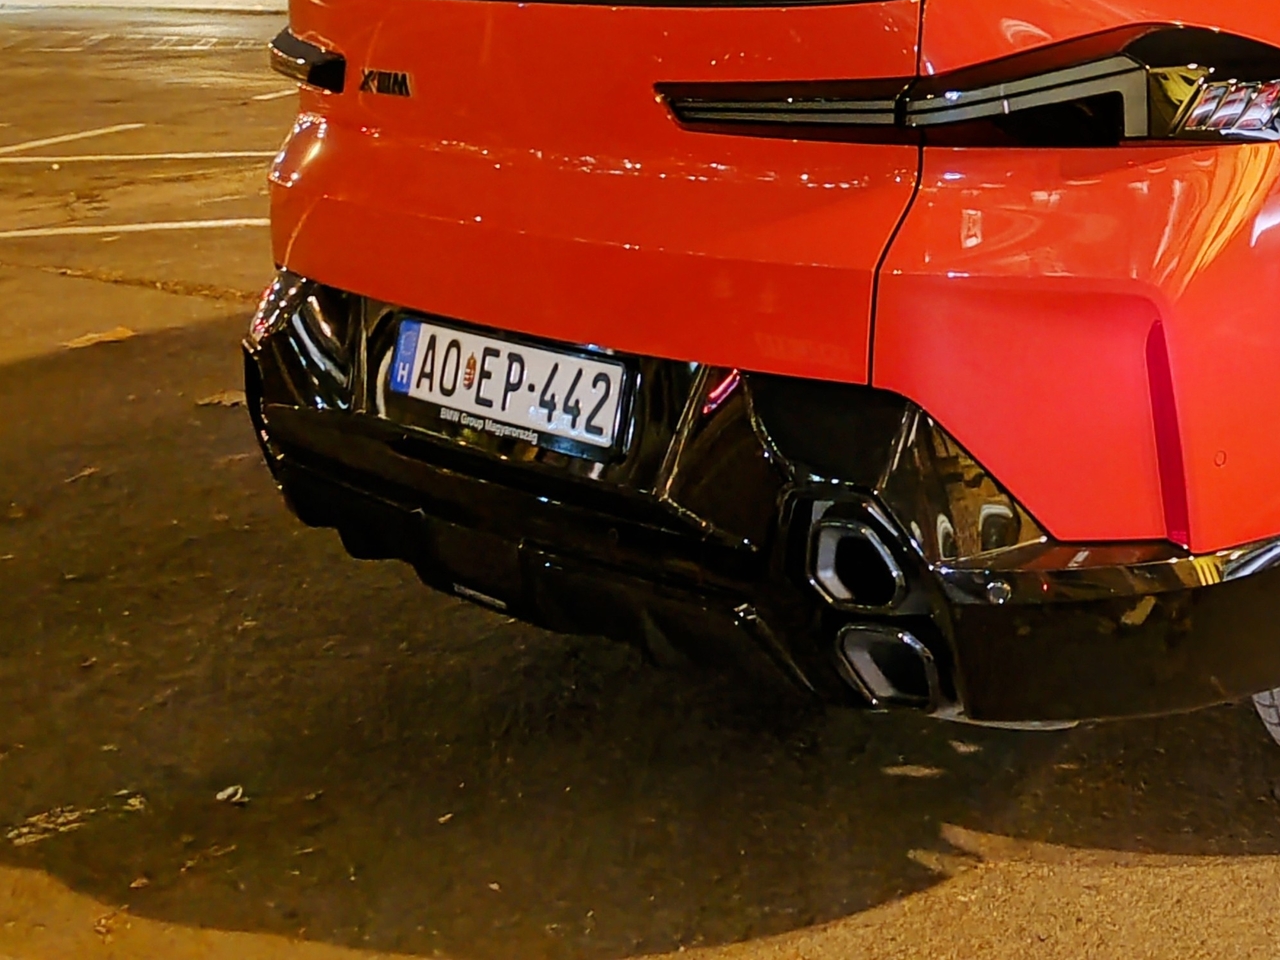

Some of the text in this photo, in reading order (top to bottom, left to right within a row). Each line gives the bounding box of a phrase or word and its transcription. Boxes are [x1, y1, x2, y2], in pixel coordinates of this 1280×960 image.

[397, 363, 408, 384] H
[440, 407, 460, 422] BMW
[460, 413, 484, 431] Group
